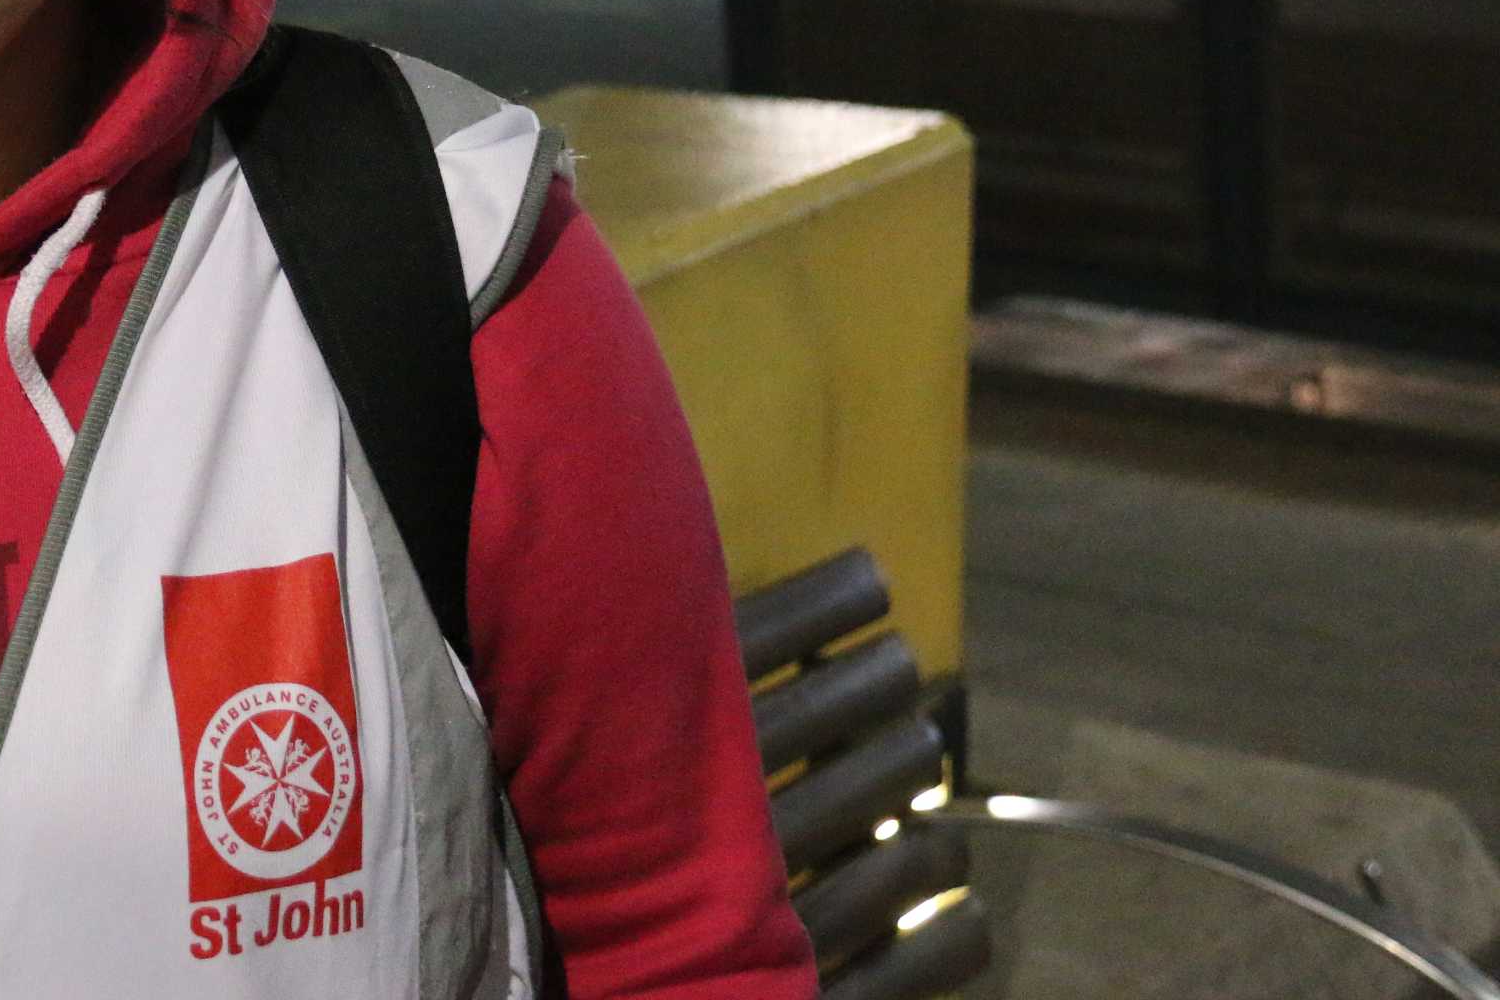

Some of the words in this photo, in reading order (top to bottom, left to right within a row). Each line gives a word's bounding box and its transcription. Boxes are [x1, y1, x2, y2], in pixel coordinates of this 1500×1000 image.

[209, 690, 319, 749] AMBULANCE
[202, 760, 220, 820] JOHN
[322, 716, 350, 838] AUSTRALIA
[217, 832, 240, 855] ST
[188, 901, 243, 960] St
[254, 880, 364, 948] John
